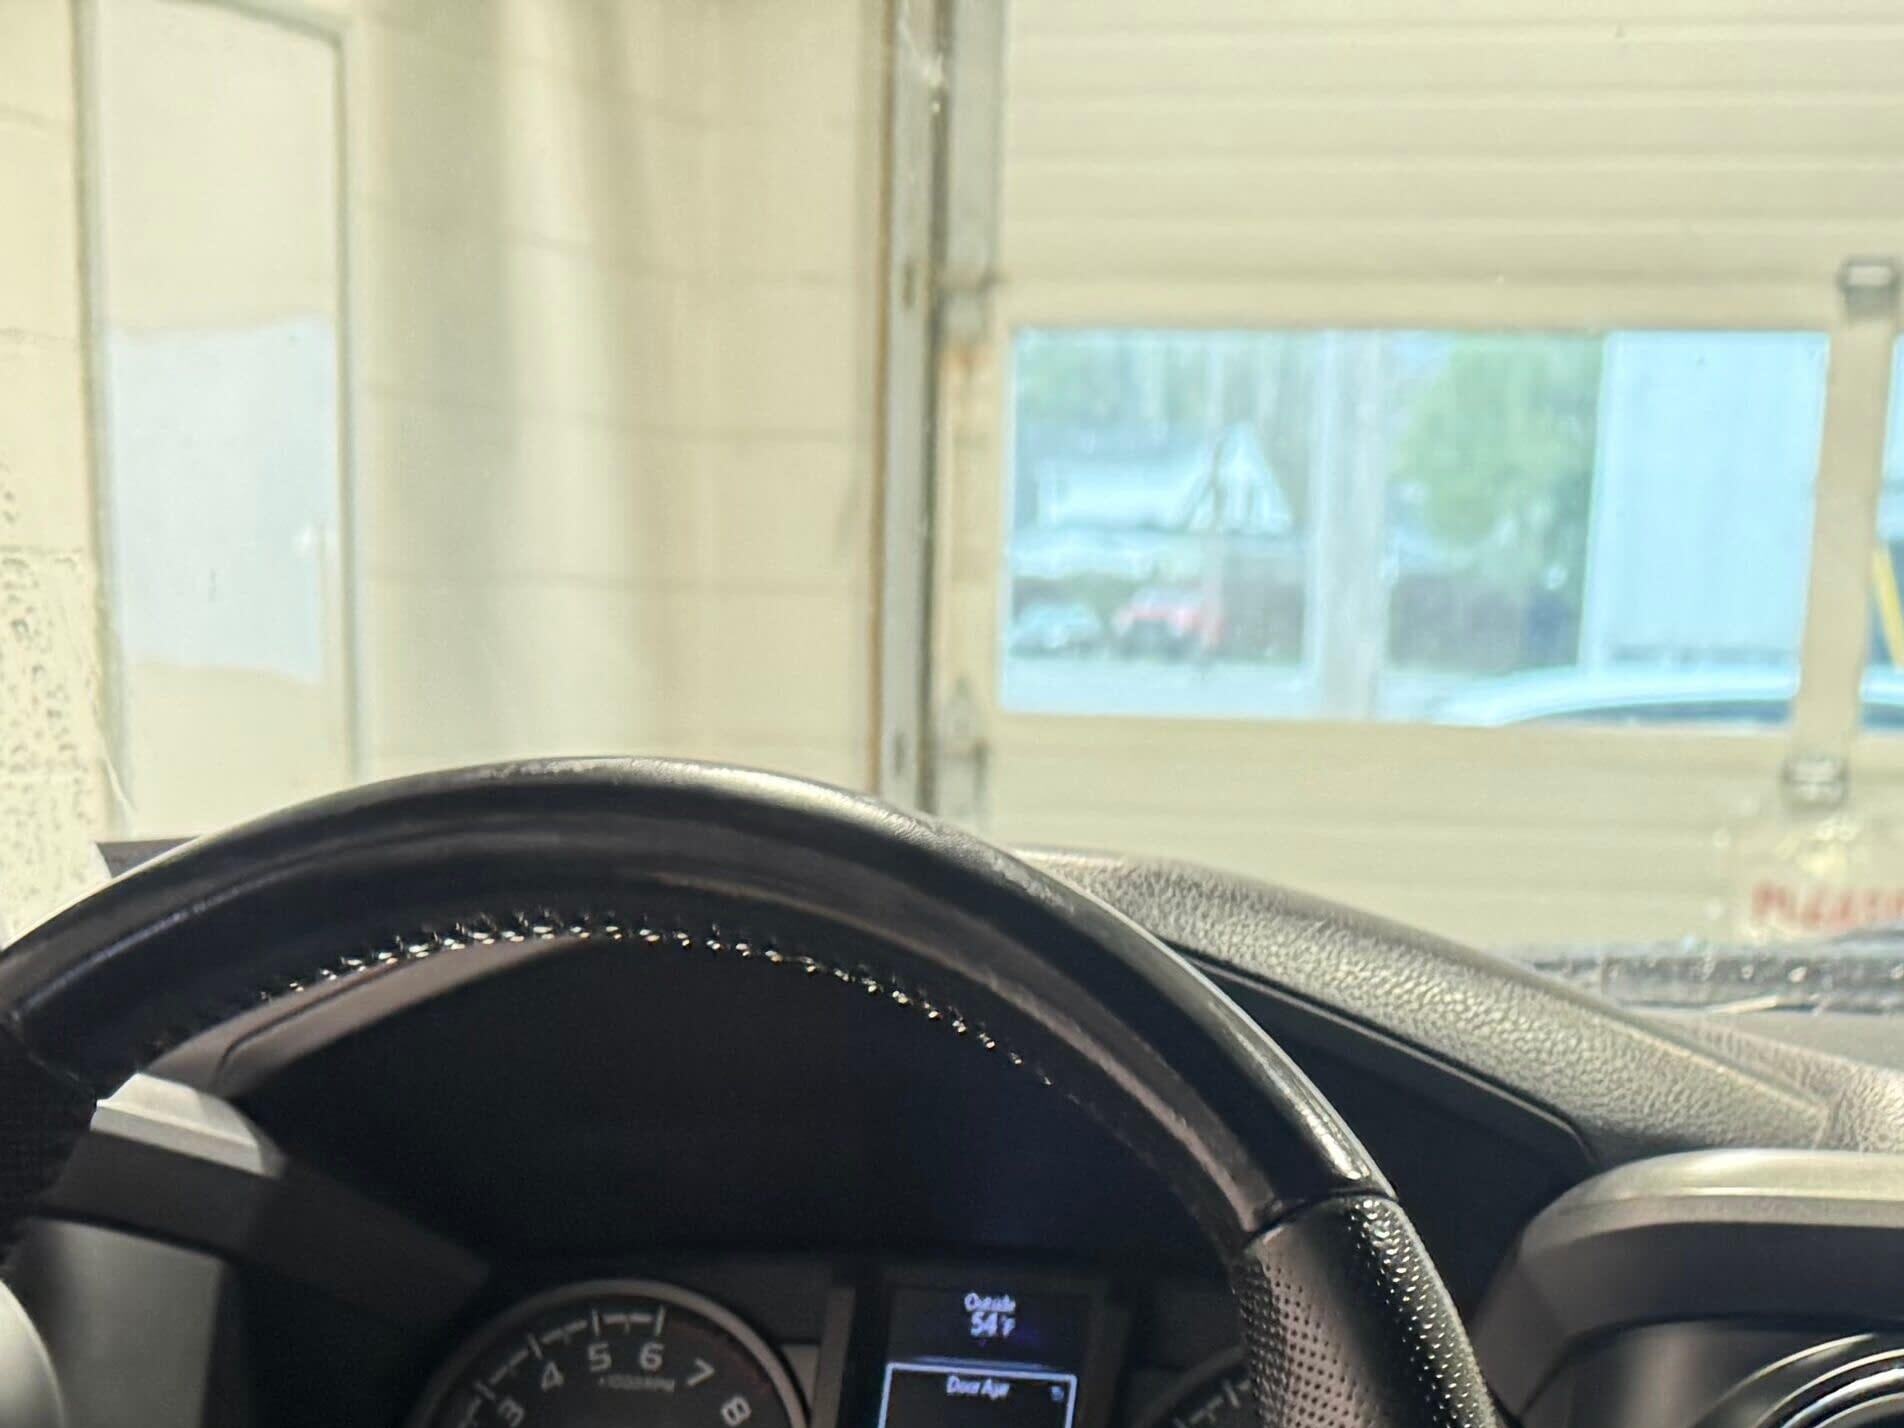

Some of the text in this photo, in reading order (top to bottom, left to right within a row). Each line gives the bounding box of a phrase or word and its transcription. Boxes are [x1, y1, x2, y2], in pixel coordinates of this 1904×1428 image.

[587, 1343, 613, 1372] 5
[640, 1343, 665, 1371] 6
[541, 1361, 574, 1391] 4
[687, 1358, 715, 1386] 7
[498, 1399, 525, 1428] 3
[720, 1396, 752, 1428] 8
